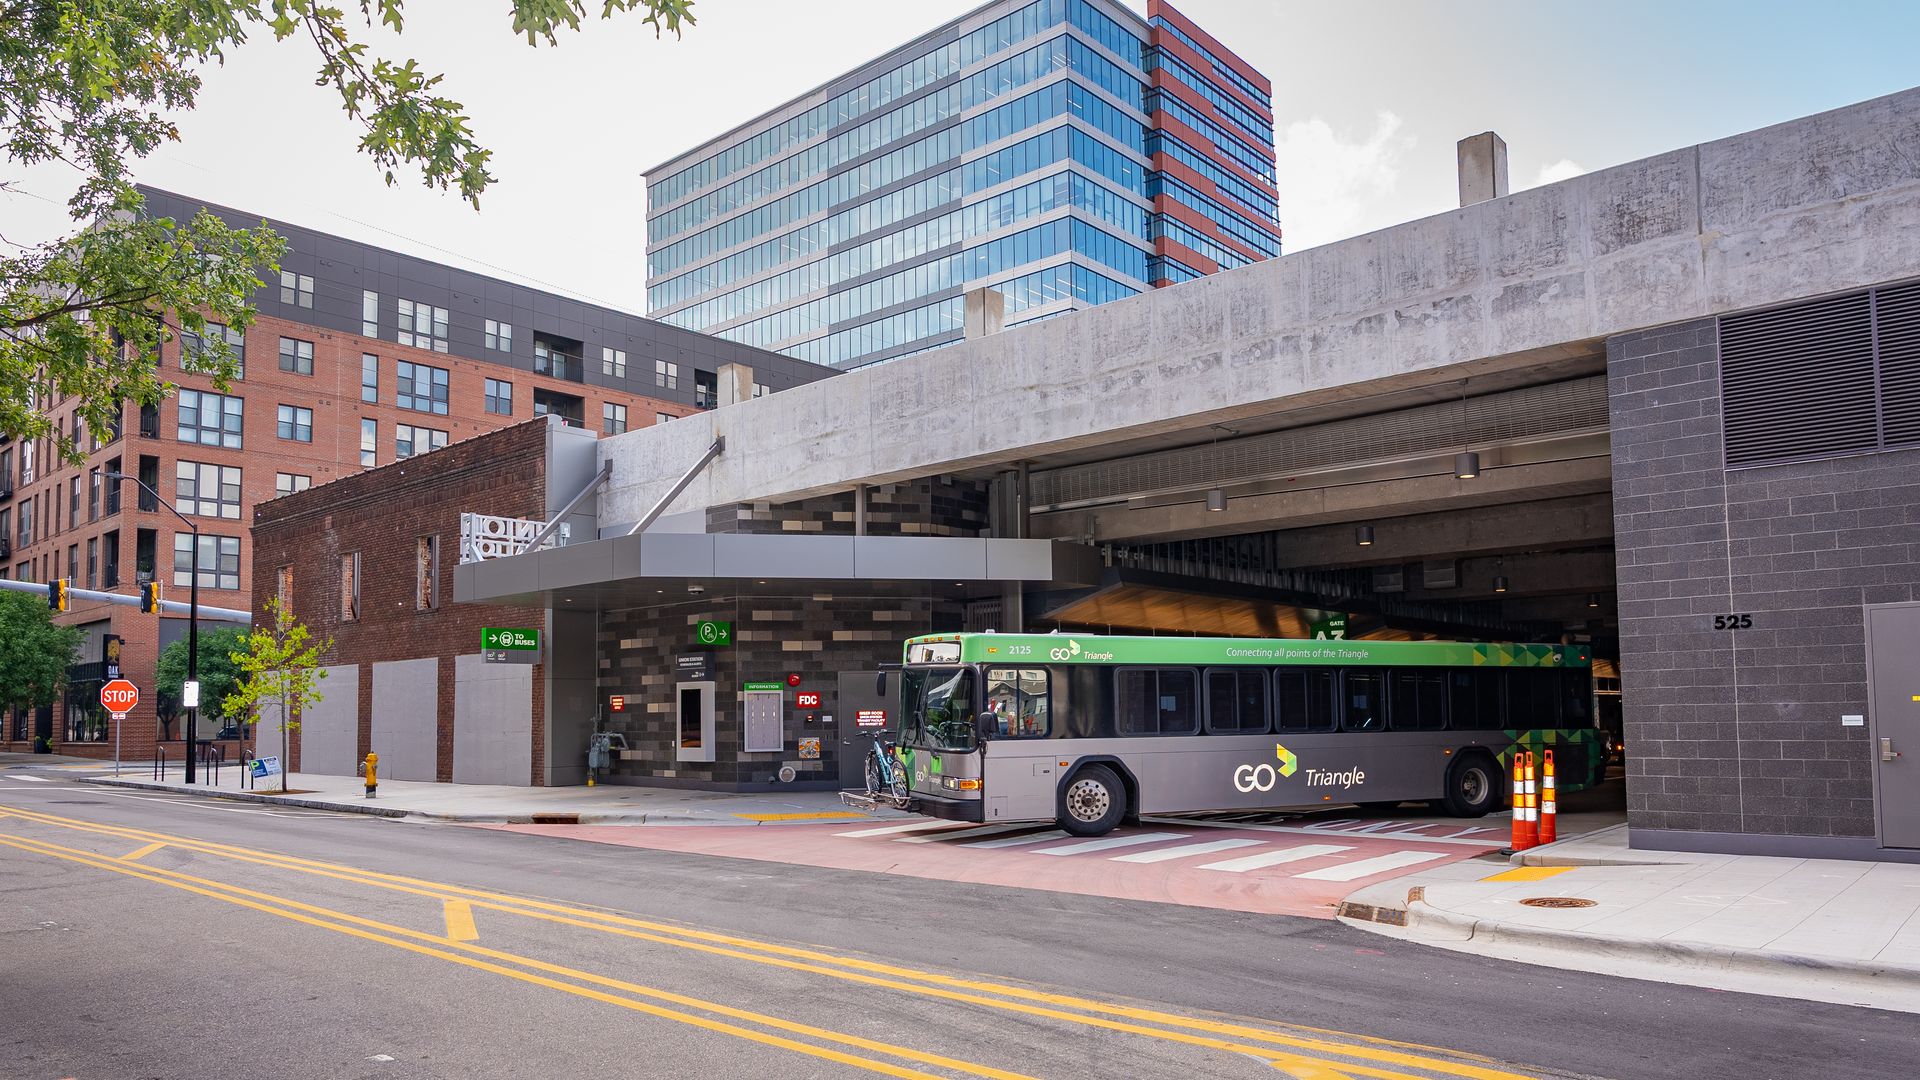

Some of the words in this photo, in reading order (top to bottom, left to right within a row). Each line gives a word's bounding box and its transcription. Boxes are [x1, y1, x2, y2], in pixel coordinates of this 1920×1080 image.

[1714, 614, 1753, 630] 525
[704, 626, 711, 636] P
[1009, 645, 1031, 655] 2125
[1050, 648, 1070, 661] GO
[1083, 650, 1114, 662] Triangle
[1226, 647, 1272, 659] Connecting
[1274, 647, 1284, 657] all
[1286, 648, 1310, 659] points
[1312, 648, 1322, 657] of
[1323, 649, 1335, 658] the
[1338, 649, 1369, 660] Triangle
[104, 690, 136, 703] STOP
[799, 695, 818, 705] FDC
[1233, 763, 1276, 793] GO
[1305, 765, 1365, 790] Triangle
[1301, 818, 1500, 839] ONLY
